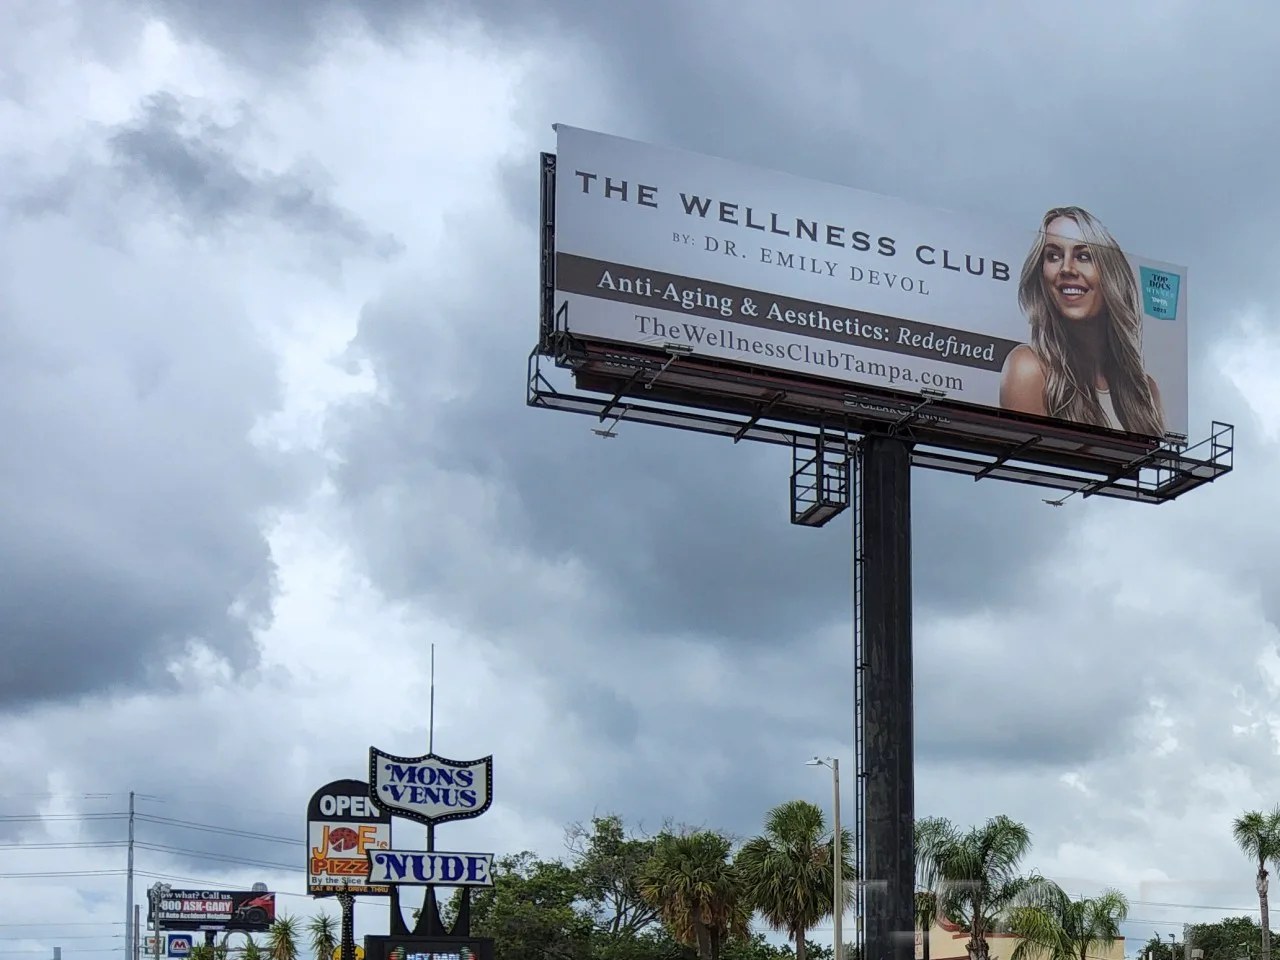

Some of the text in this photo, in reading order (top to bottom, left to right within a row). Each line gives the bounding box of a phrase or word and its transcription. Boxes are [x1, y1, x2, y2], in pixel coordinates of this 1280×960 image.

[575, 170, 1010, 282] THE WELLNESS CLUB
[672, 232, 930, 295] BY: DR. EMILY DEVOL
[1151, 273, 1169, 283] TOP
[597, 270, 995, 362] Anti-Aging & Aesthetics: Redefined
[634, 314, 964, 391] TheWellnessClubTampa.com
[385, 763, 473, 788] MONS
[319, 795, 380, 818] OPEN
[382, 784, 477, 809] VENUS
[311, 858, 369, 876] PIZZ
[375, 852, 488, 883] NUDE
[311, 876, 362, 886] By the Slice
[370, 886, 389, 894] THRU
[175, 891, 200, 899] what?
[201, 891, 220, 900] Call
[182, 900, 231, 912] ASK-GARY
